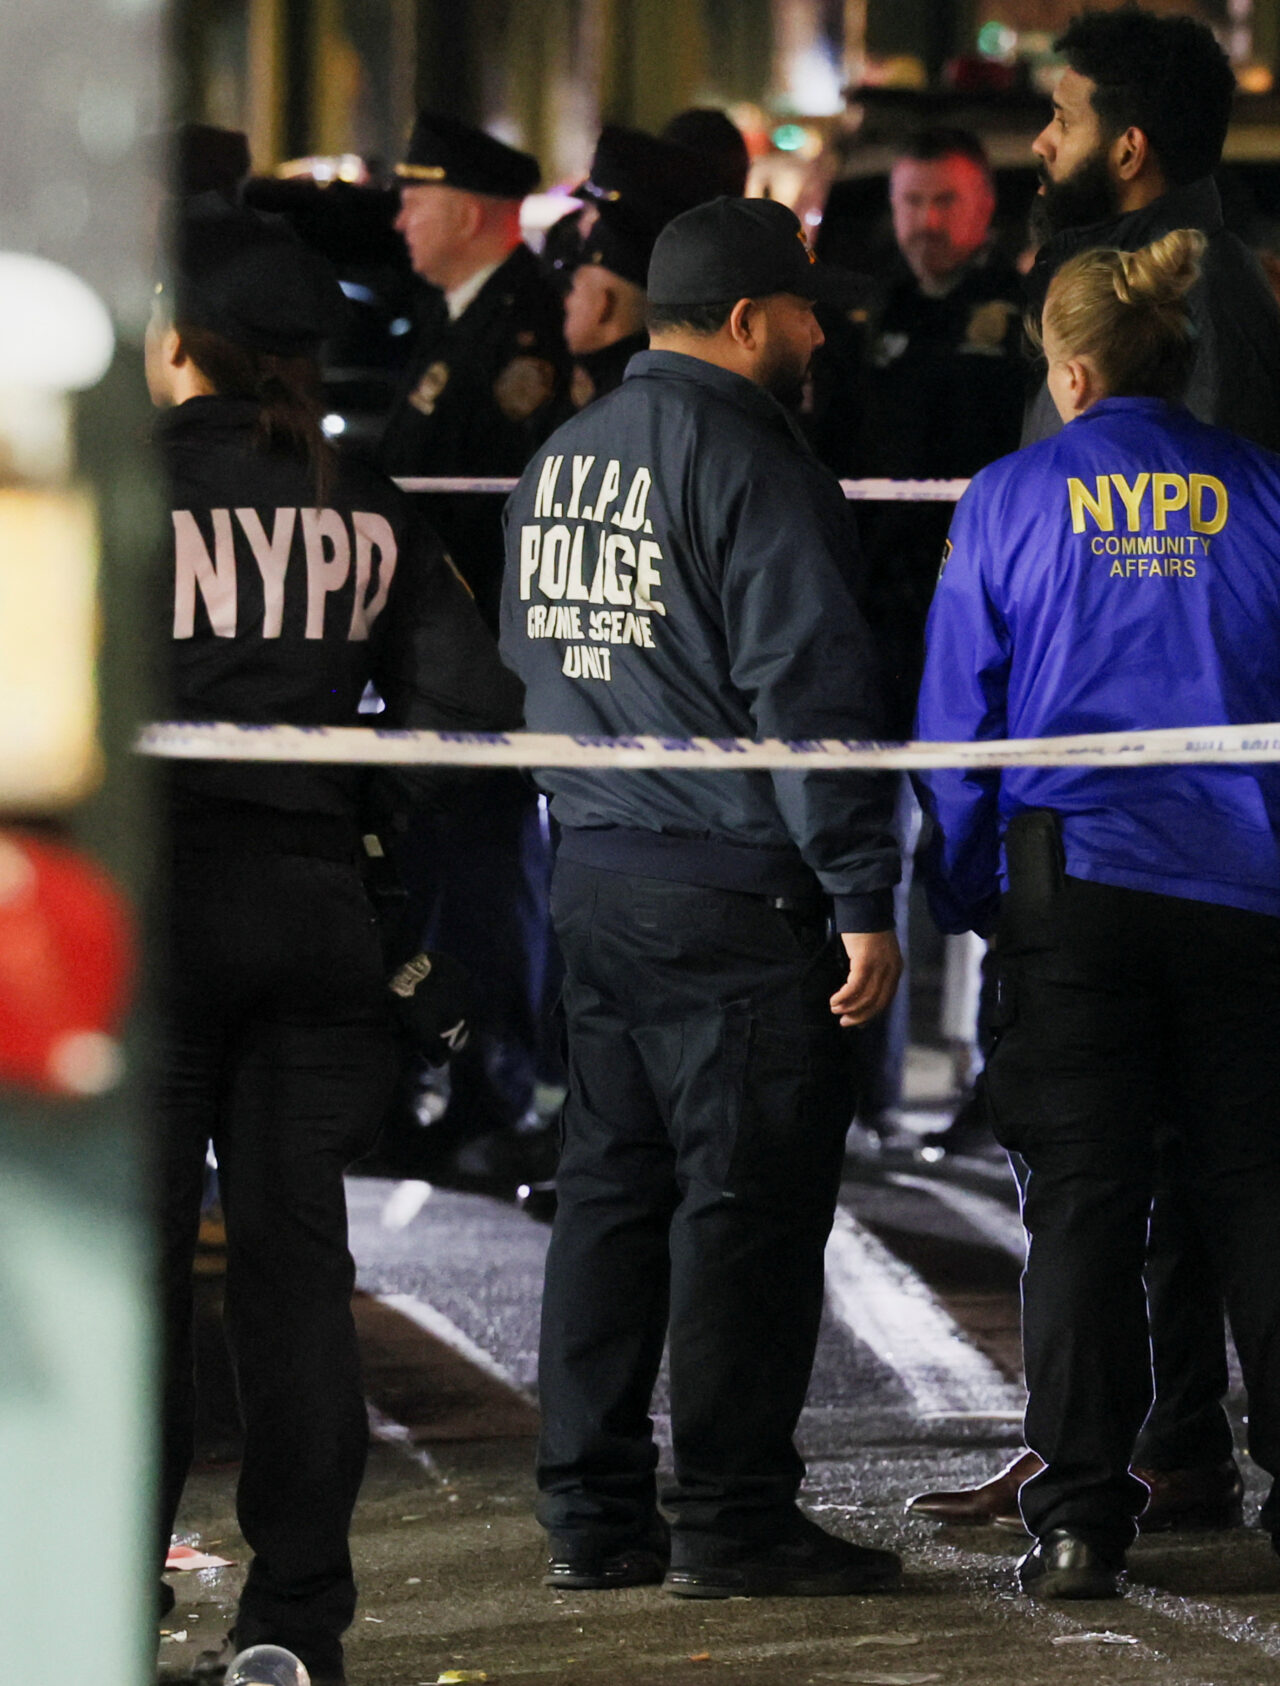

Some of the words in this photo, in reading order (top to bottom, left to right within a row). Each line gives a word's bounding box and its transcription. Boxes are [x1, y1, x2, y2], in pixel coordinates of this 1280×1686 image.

[1067, 472, 1228, 535] NYPD
[1091, 536, 1211, 556] COMMUNITY
[171, 507, 398, 641] NYPD
[519, 524, 666, 616] POLICE
[1109, 558, 1197, 578] AFFAIRS
[527, 605, 585, 639] CRIME
[588, 609, 656, 648] SCENE
[562, 645, 611, 681] UNIT
